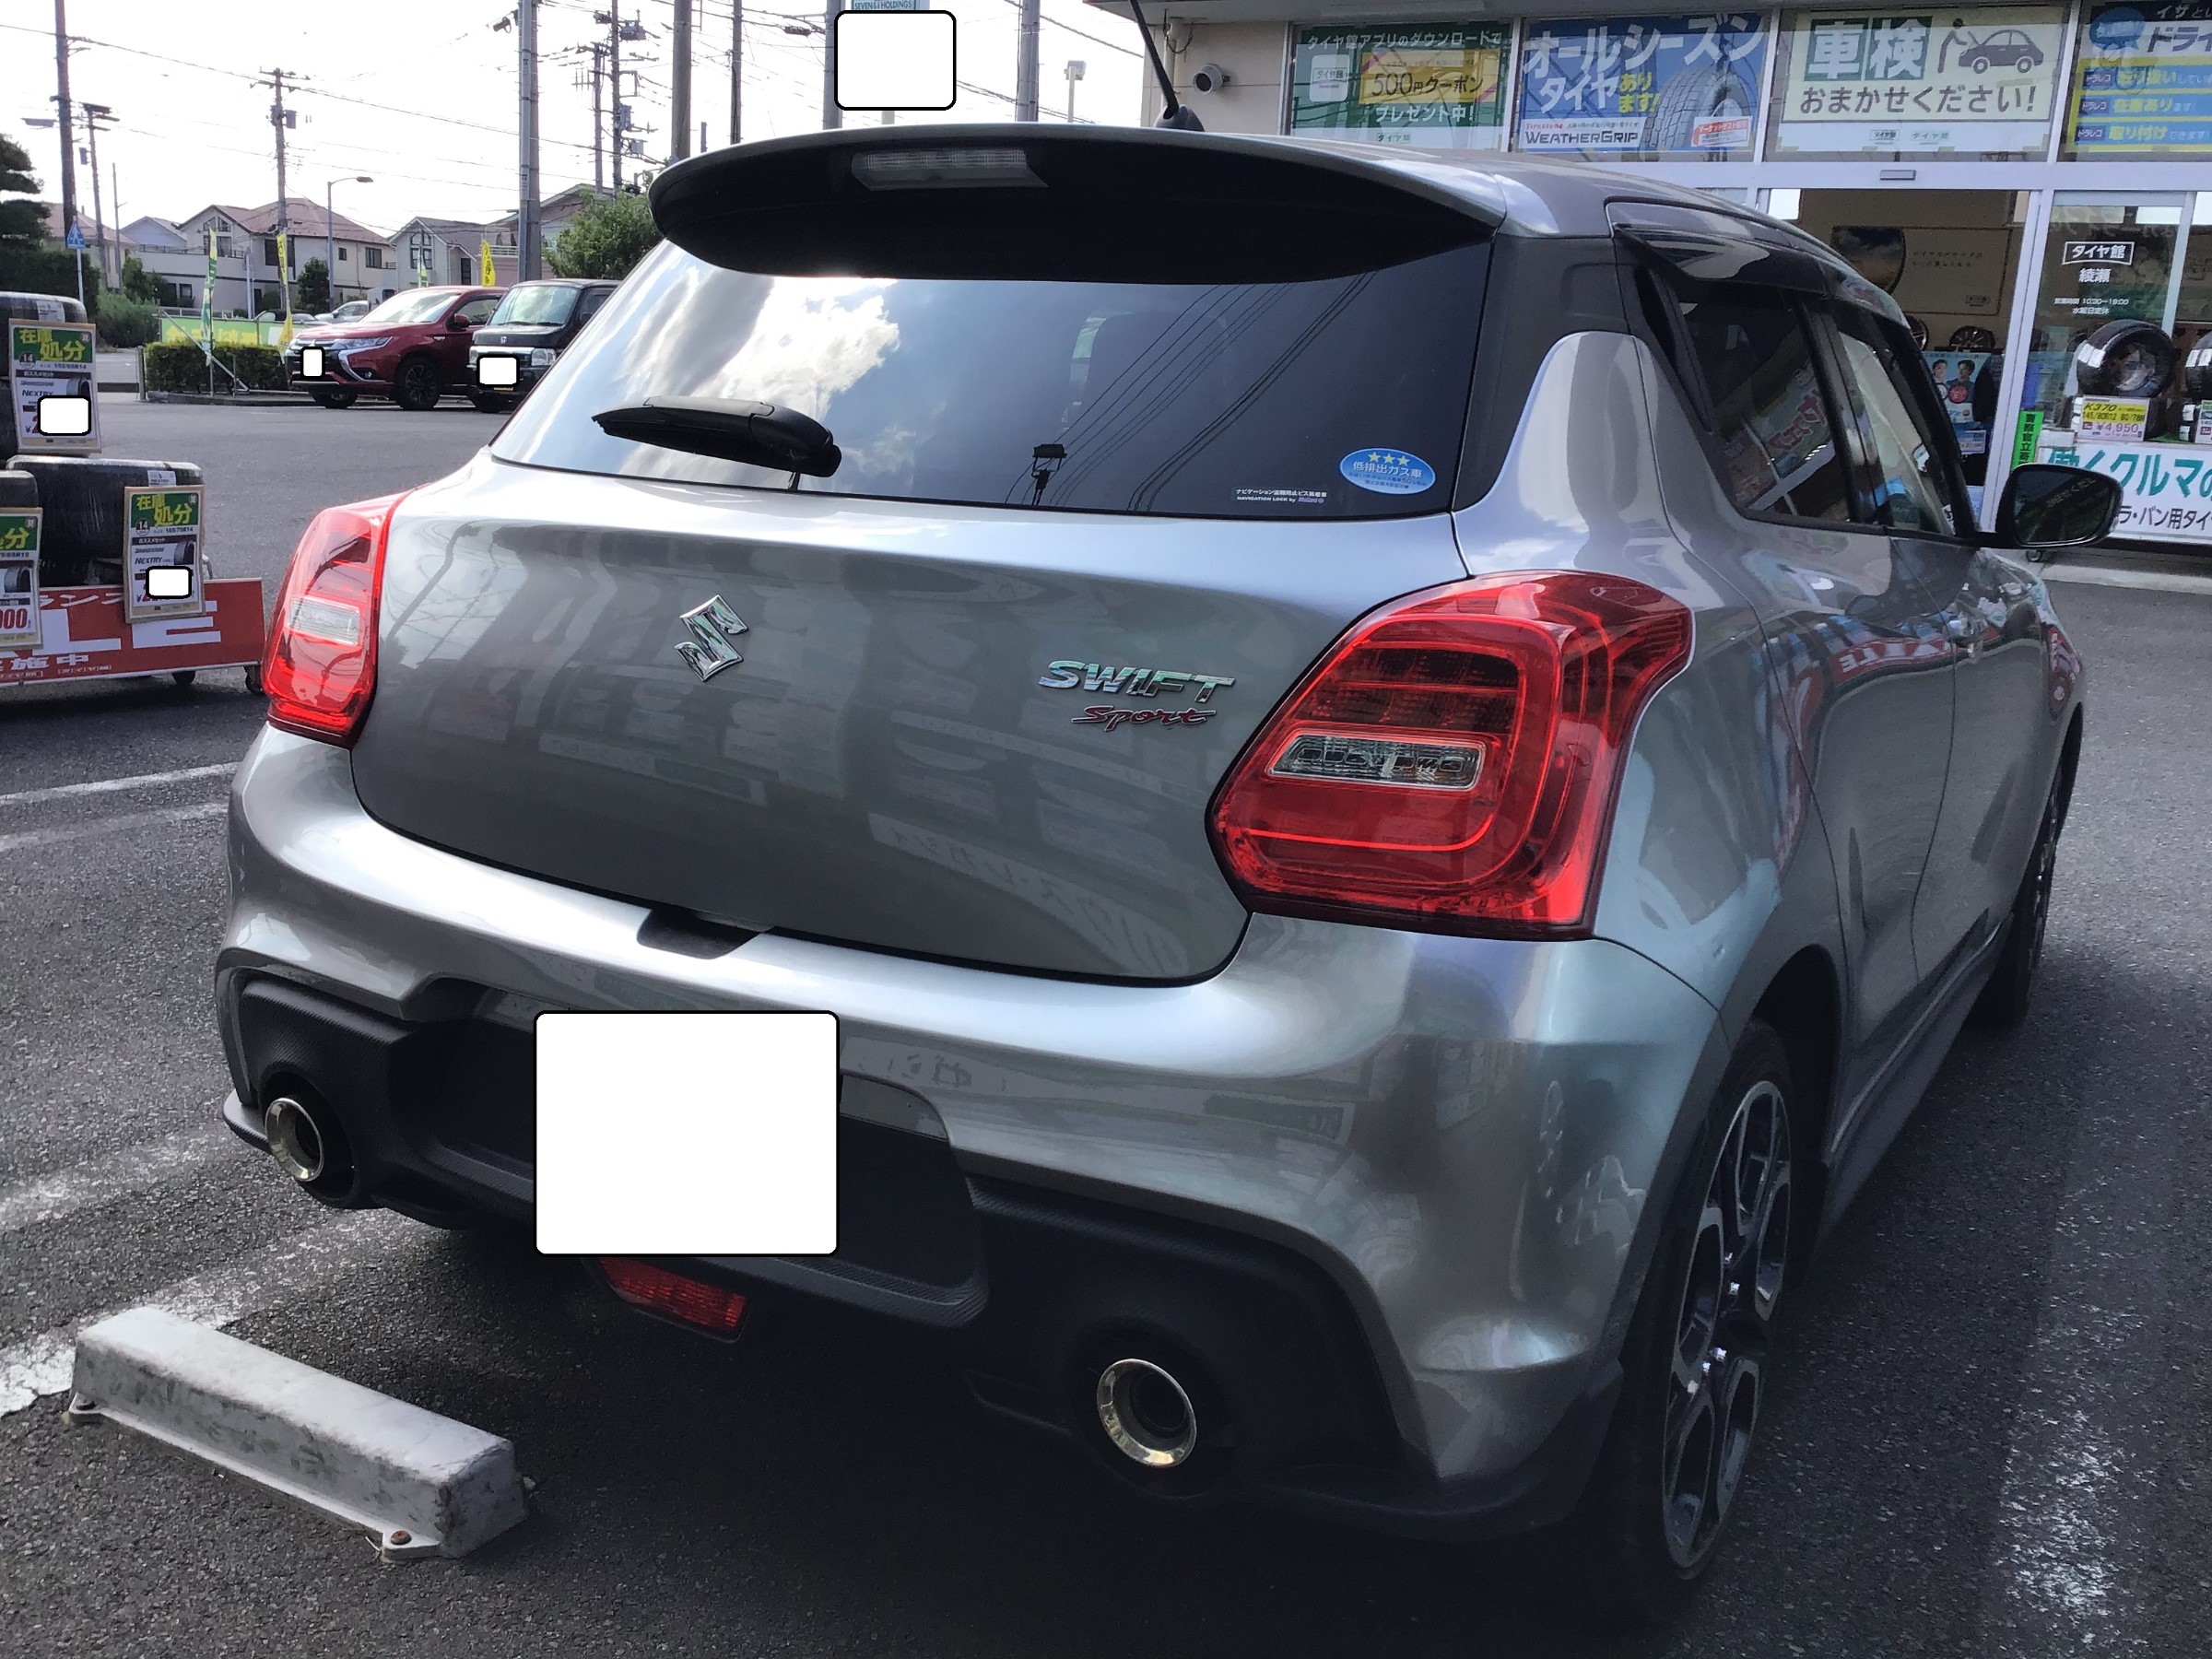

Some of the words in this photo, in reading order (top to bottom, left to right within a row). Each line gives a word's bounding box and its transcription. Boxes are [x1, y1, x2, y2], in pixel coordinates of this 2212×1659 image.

[1308, 30, 1501, 50] タイヤ館アプリのダウンロードで
[1523, 13, 1766, 78] オールシーズン
[1807, 18, 1931, 79] 車検
[1371, 72, 1483, 96] 500円クーポン
[1540, 72, 1620, 113] タイヤ
[2072, 245, 2126, 259] タイヤ館
[2078, 268, 2112, 282] 綾瀬
[19, 329, 53, 344] 在庫
[40, 340, 86, 361] 処分
[2084, 403, 2118, 412] K370
[1353, 461, 1423, 477] 低排出ガス車
[137, 494, 166, 510] 在庫
[154, 503, 192, 527] 処分
[0, 527, 29, 548] 分
[0, 653, 89, 672] 施中
[1038, 660, 1237, 703] SWIFT
[1071, 705, 1217, 732] Sport
